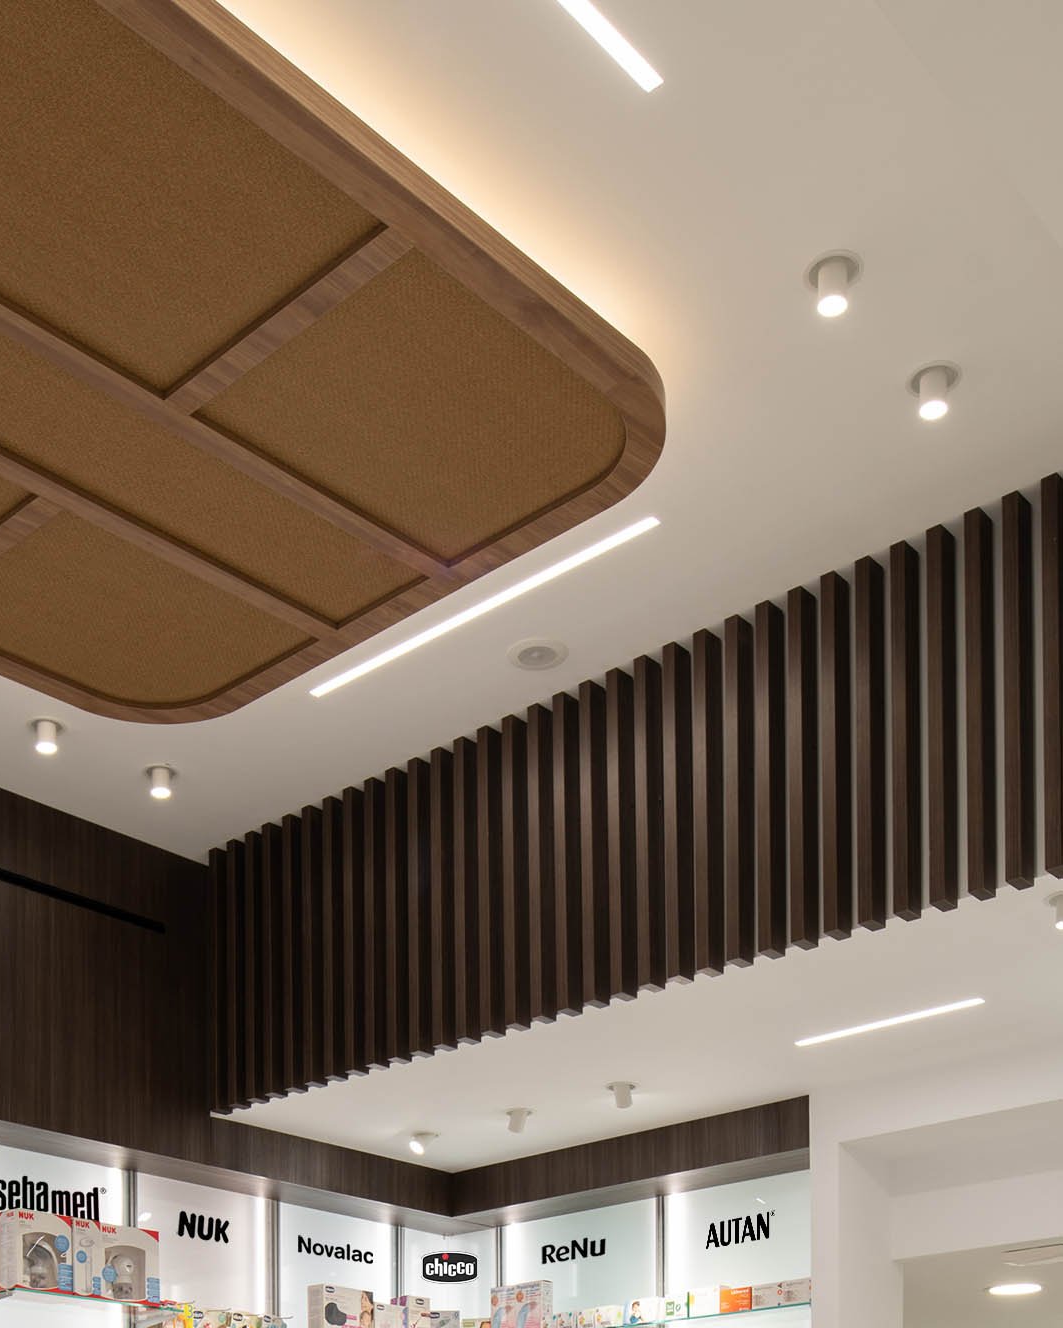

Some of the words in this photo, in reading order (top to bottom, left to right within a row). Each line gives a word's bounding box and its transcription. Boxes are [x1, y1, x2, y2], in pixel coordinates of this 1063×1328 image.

[18, 1211, 35, 1221] NUK
[75, 1219, 90, 1229] NUK
[178, 1211, 229, 1243] NUK
[102, 1225, 117, 1235] NUK
[298, 1235, 374, 1264] Novalac
[541, 1237, 606, 1264] ReNu
[425, 1253, 475, 1277] chicco
